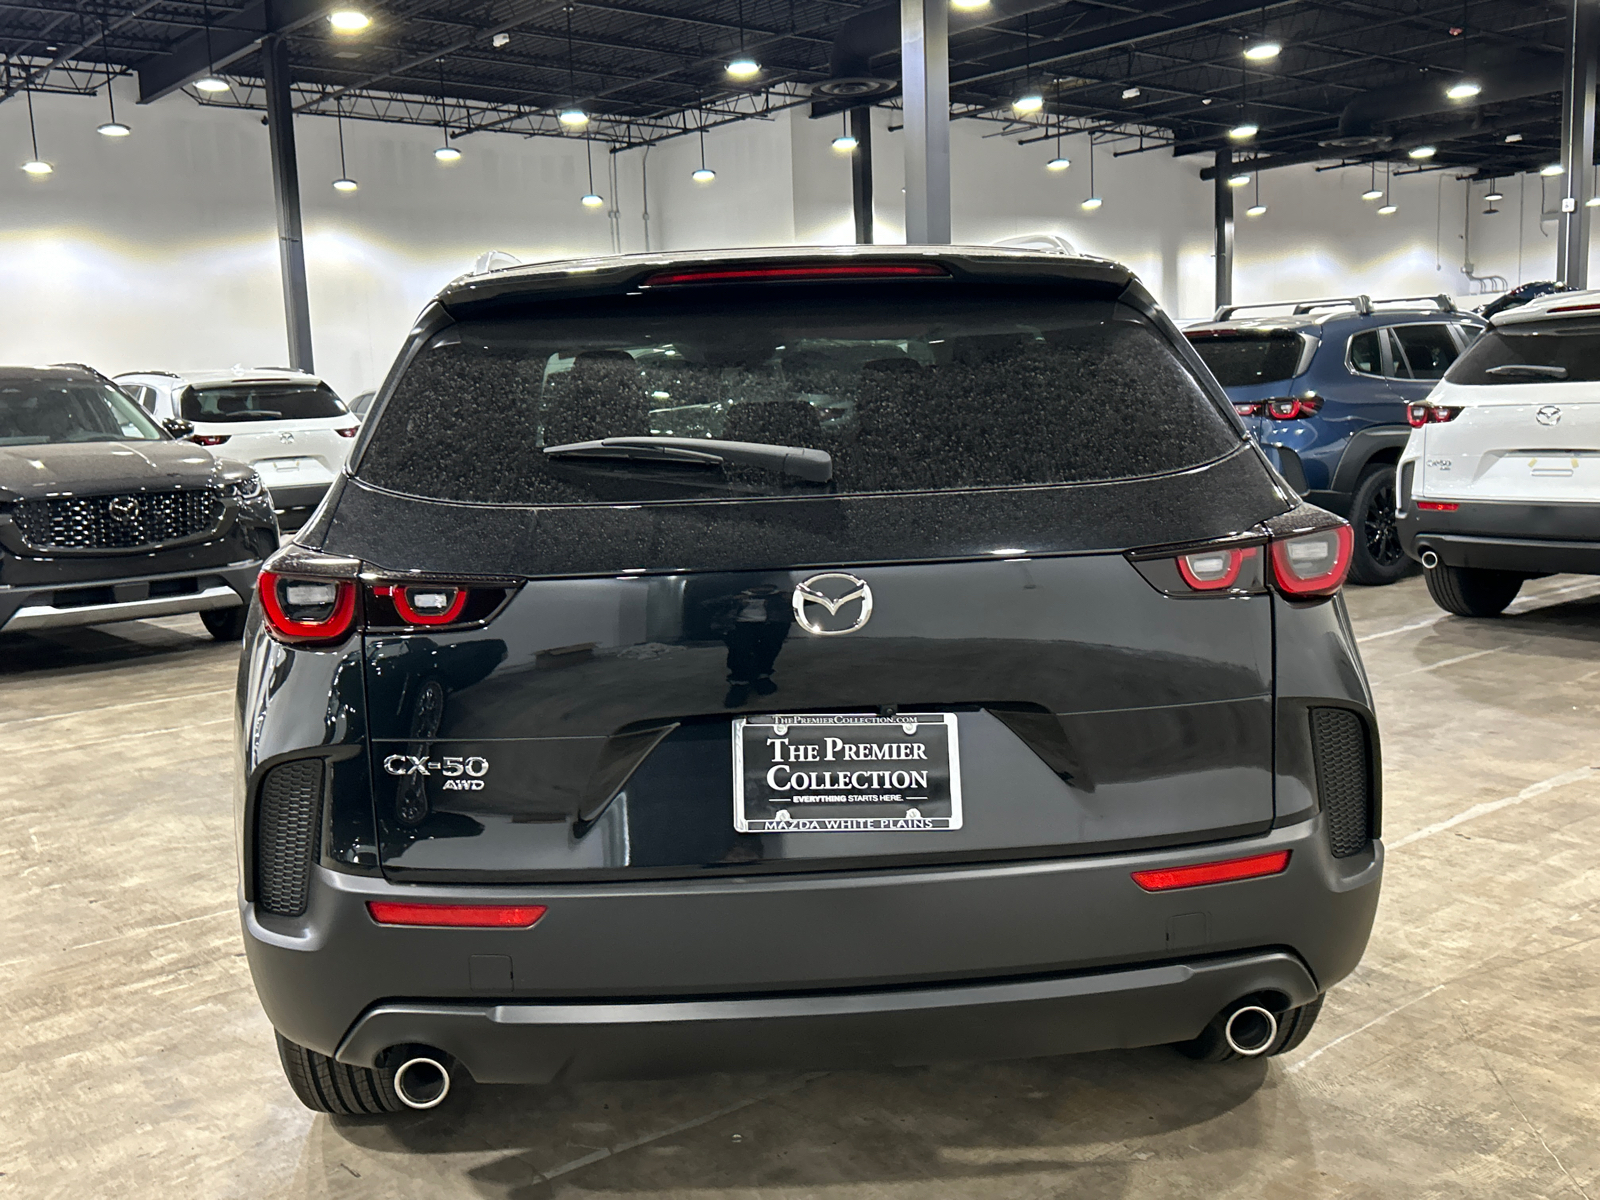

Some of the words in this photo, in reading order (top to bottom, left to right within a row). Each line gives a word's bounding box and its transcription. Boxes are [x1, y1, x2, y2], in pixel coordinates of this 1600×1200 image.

[766, 738, 820, 762] THE
[823, 737, 928, 761] PREMIER
[383, 754, 490, 777] CX-50
[442, 780, 485, 790] AWD
[766, 764, 929, 791] COLLECTION
[792, 795, 847, 803] EVERYTHING
[848, 794, 878, 802] STARTS
[764, 820, 820, 830] MAZDA
[824, 819, 874, 829] WHITE
[880, 819, 933, 829] PLAINS
